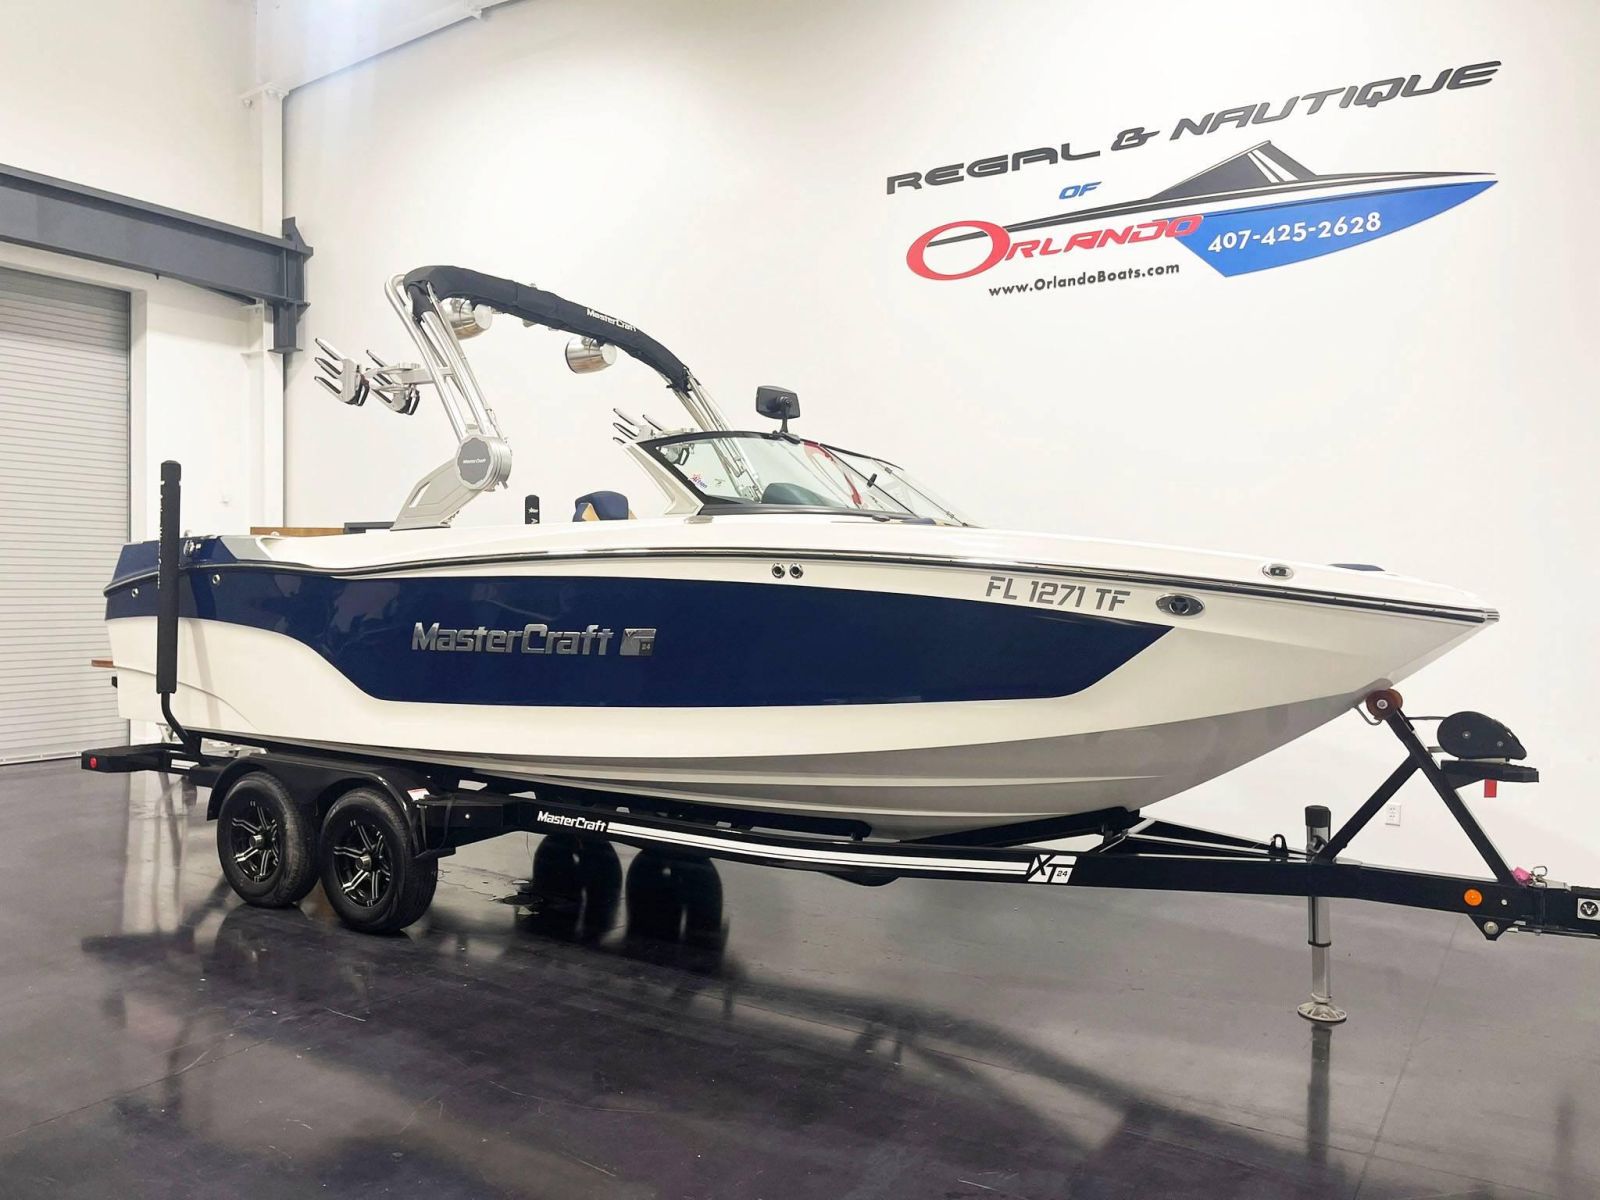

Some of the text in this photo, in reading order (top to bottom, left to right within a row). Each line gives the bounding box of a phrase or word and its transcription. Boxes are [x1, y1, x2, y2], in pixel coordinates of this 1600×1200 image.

[887, 60, 1502, 195] REGAL & NAUTIQUE
[1058, 181, 1102, 200] OF
[1207, 211, 1382, 253] 407-425-2628
[989, 263, 1180, 296] www.OrlandoBoats.com
[586, 308, 637, 332] MasterCraft
[985, 575, 1131, 611] FL 1271 TF
[411, 622, 614, 656] MasterCraft
[536, 810, 606, 832] MasterCraft
